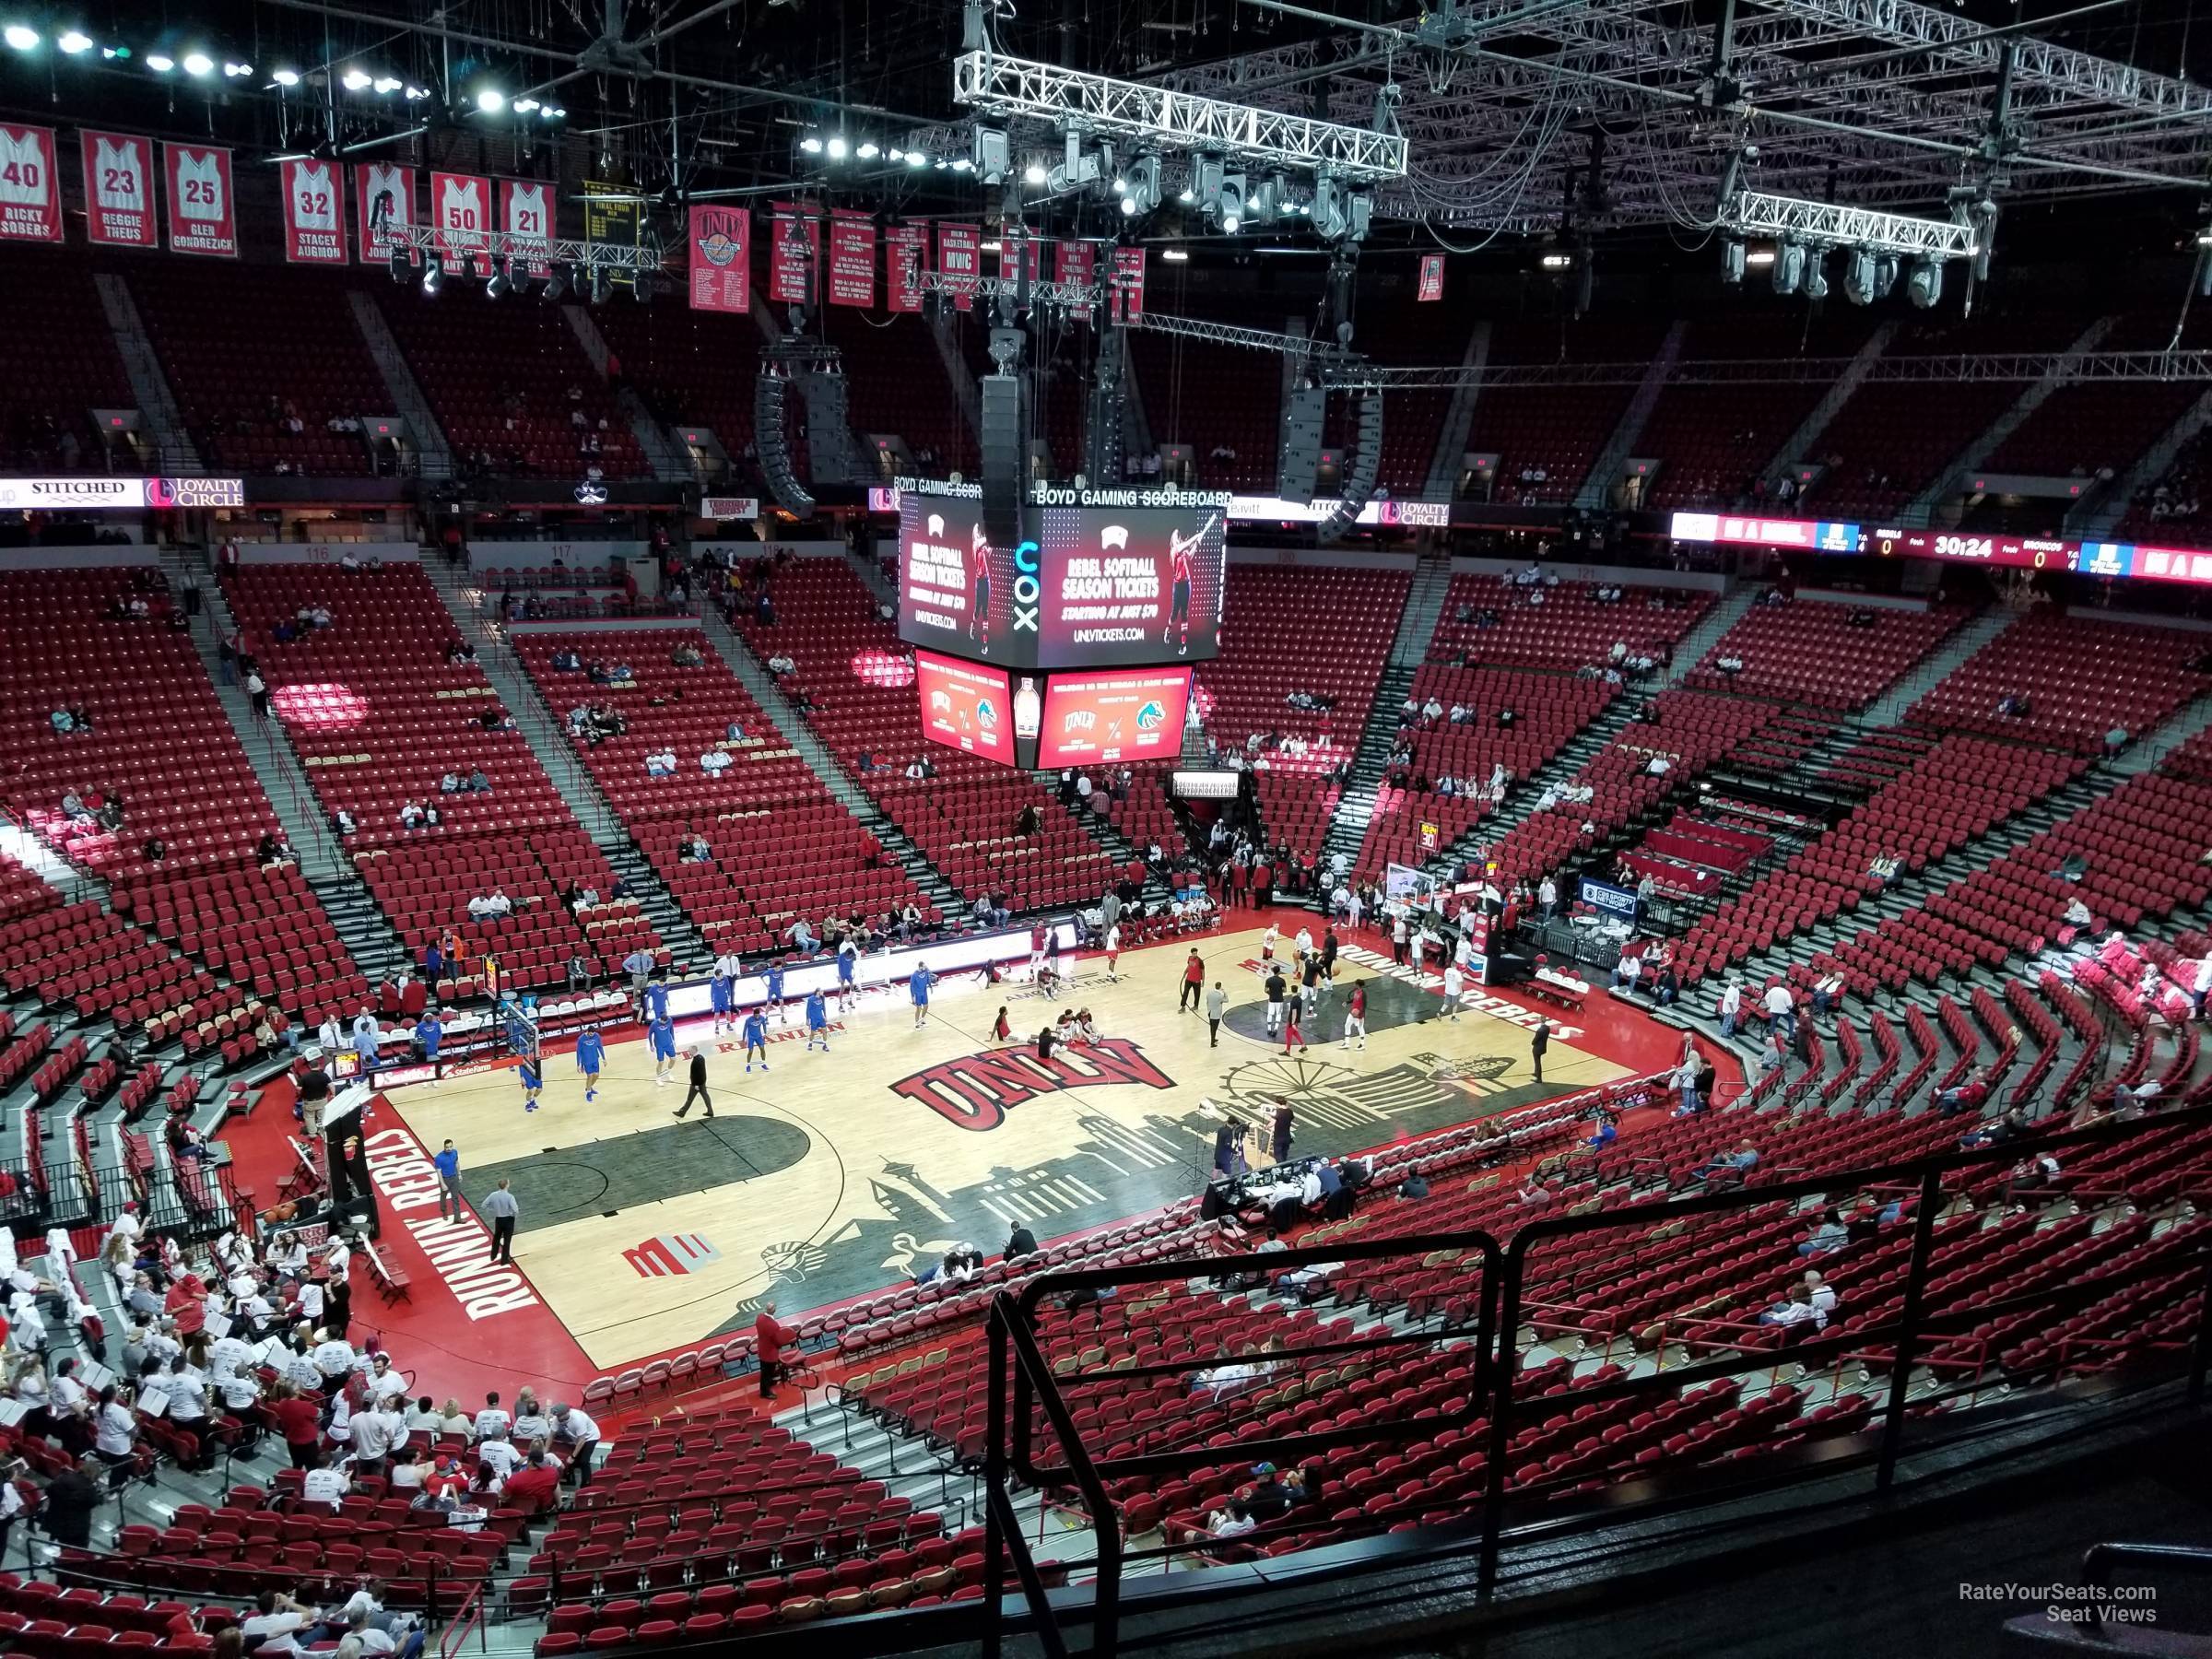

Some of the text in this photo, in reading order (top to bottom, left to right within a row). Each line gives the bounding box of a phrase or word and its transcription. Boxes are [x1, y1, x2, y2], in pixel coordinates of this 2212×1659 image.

[3, 161, 39, 188] 40
[104, 169, 135, 194] 23
[185, 180, 215, 204] 25
[301, 192, 328, 216] 32
[5, 206, 43, 221] RICKY
[102, 212, 142, 228] REGGIE
[449, 206, 476, 230] 50
[518, 210, 538, 232] 21
[1, 220, 50, 236] SOBERS
[105, 226, 142, 240] THEUS
[191, 224, 216, 237] GLEN
[697, 211, 744, 241] UNLV
[173, 236, 233, 250] GONDREZICK
[299, 233, 336, 246] STACEY
[943, 238, 976, 249] BASKETBALL
[298, 243, 340, 258] AUGMON
[946, 252, 972, 270] MWC
[32, 482, 125, 494] STITCHED
[177, 478, 241, 493] LOYALTY
[894, 476, 916, 491] BOYD
[918, 479, 953, 496] GAMING
[178, 491, 244, 506] CIRCLE
[1036, 490, 1233, 506] BOYD GAMING SCOREBOARD
[1402, 502, 1449, 515] LOYALTY
[1402, 512, 1448, 525] CIRCLE
[306, 547, 329, 560] 116
[552, 545, 571, 558] 117
[1882, 539, 1892, 555] 0
[1935, 535, 1993, 559] 30:24
[2022, 539, 2063, 553] BRONCOS
[2034, 551, 2046, 568] 0
[1067, 558, 1156, 577] REBEL SOFTBALL
[1014, 542, 1040, 631] COX
[1062, 576, 1159, 600] SEASON TICKETS
[1061, 606, 1107, 620] STARTING
[1106, 605, 1121, 619] AT
[1074, 628, 1145, 642] UNLVTICKETS.COM
[1065, 710, 1097, 734] UNLV
[1421, 833, 1434, 848] 30
[1597, 895, 1628, 909] NETWORK
[1609, 892, 1633, 904] SPORTS
[600, 1018, 617, 1028] UMC
[618, 1016, 634, 1025] UMC
[545, 1030, 561, 1038] UMC
[563, 1026, 581, 1034] UMC
[888, 1038, 1179, 1132] UNLV
[364, 1128, 453, 1211] REBELS
